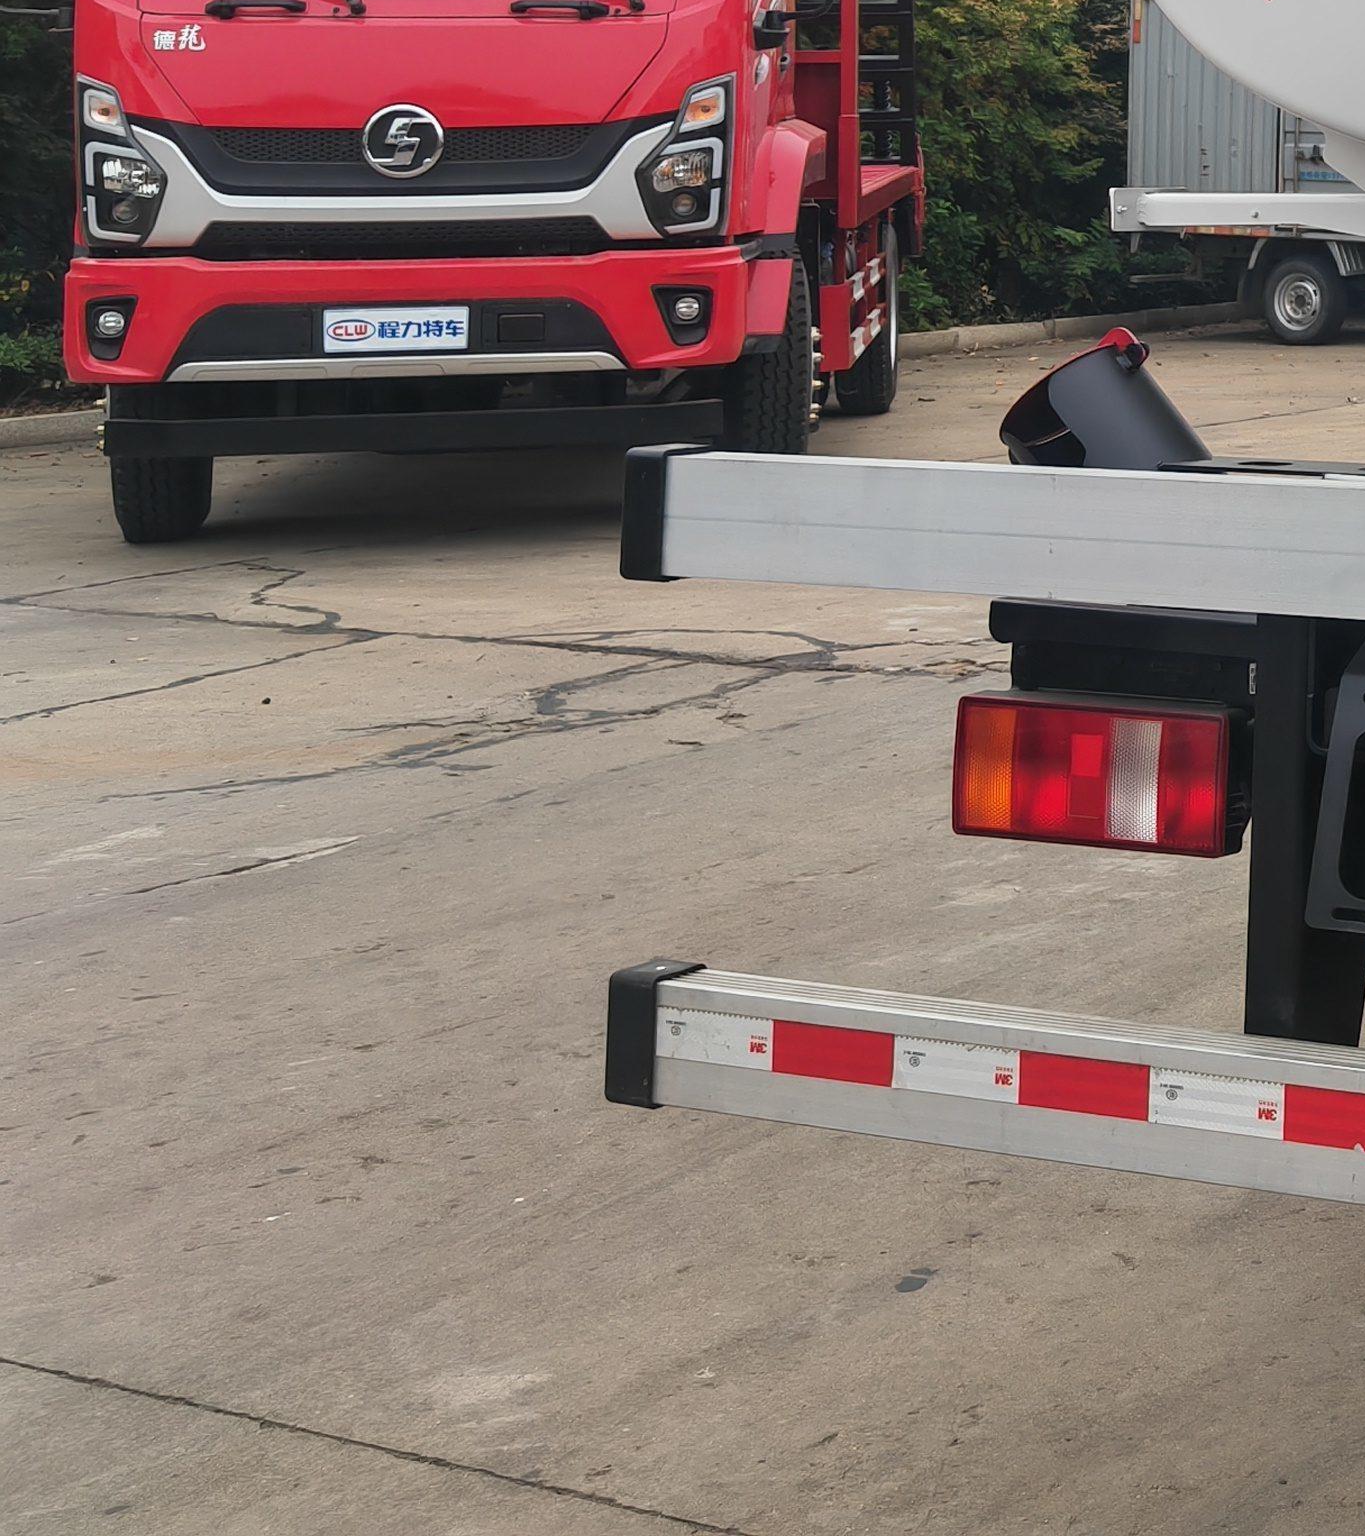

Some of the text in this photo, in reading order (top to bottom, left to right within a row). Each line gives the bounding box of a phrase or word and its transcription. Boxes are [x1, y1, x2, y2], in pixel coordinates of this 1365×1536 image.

[332, 319, 465, 339] CLW 程力特车
[749, 1041, 767, 1054] 3M
[994, 1072, 1013, 1086] 3M
[1257, 1107, 1277, 1121] 3M
